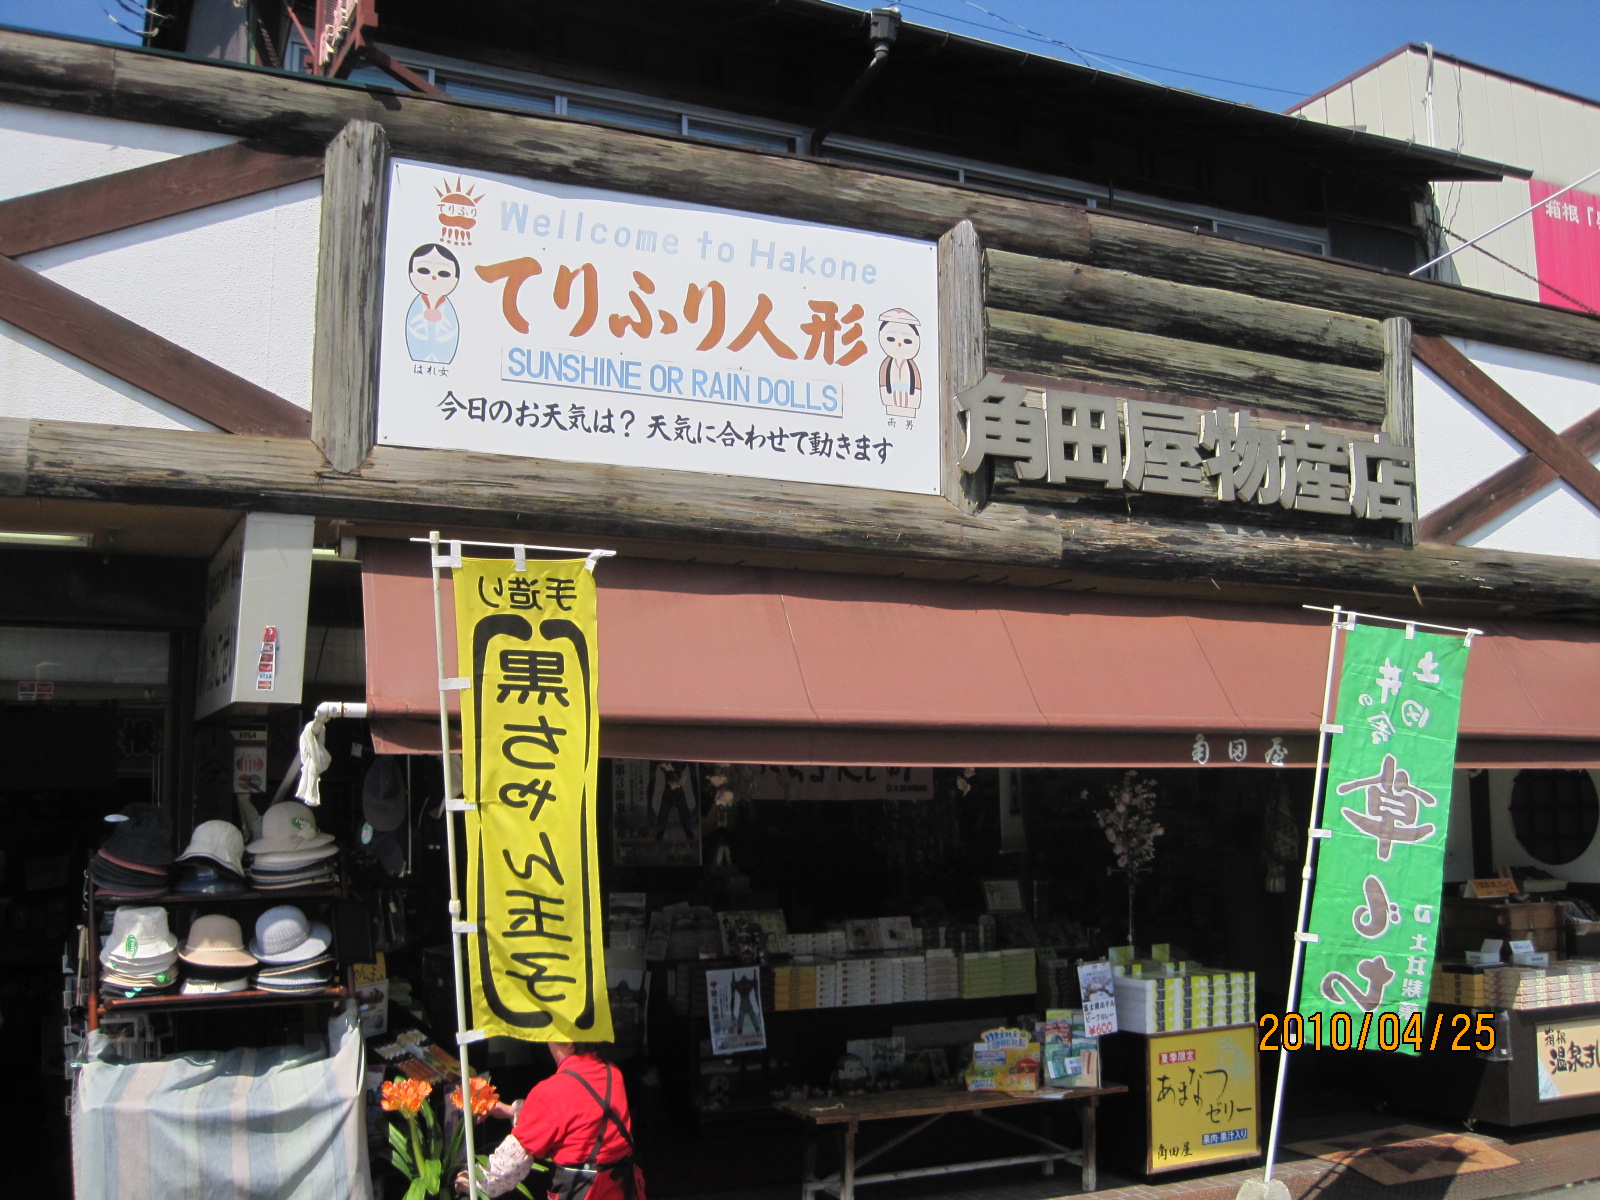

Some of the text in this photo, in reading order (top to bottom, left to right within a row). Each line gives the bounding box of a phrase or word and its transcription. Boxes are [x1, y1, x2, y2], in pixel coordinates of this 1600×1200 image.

[436, 203, 478, 218] てりふり
[501, 201, 878, 285] Wellcome to Hakone
[474, 256, 868, 366] てりふり人形
[413, 364, 450, 378] はれ女
[508, 347, 838, 411] SUNSHINE OR RAIN DOLLS
[646, 414, 894, 464] 天気に合わせて動きます
[956, 372, 1414, 523] 角田屋物産店
[239, 731, 257, 739] VISA
[1089, 1022, 1113, 1035] ¥600
[1544, 1027, 1567, 1046] 箱根
[1160, 1050, 1195, 1064] 夏季限定
[1156, 1066, 1228, 1111] あまなつ
[1205, 1099, 1252, 1123] ゼリー
[1157, 1141, 1193, 1160] 角田屋
